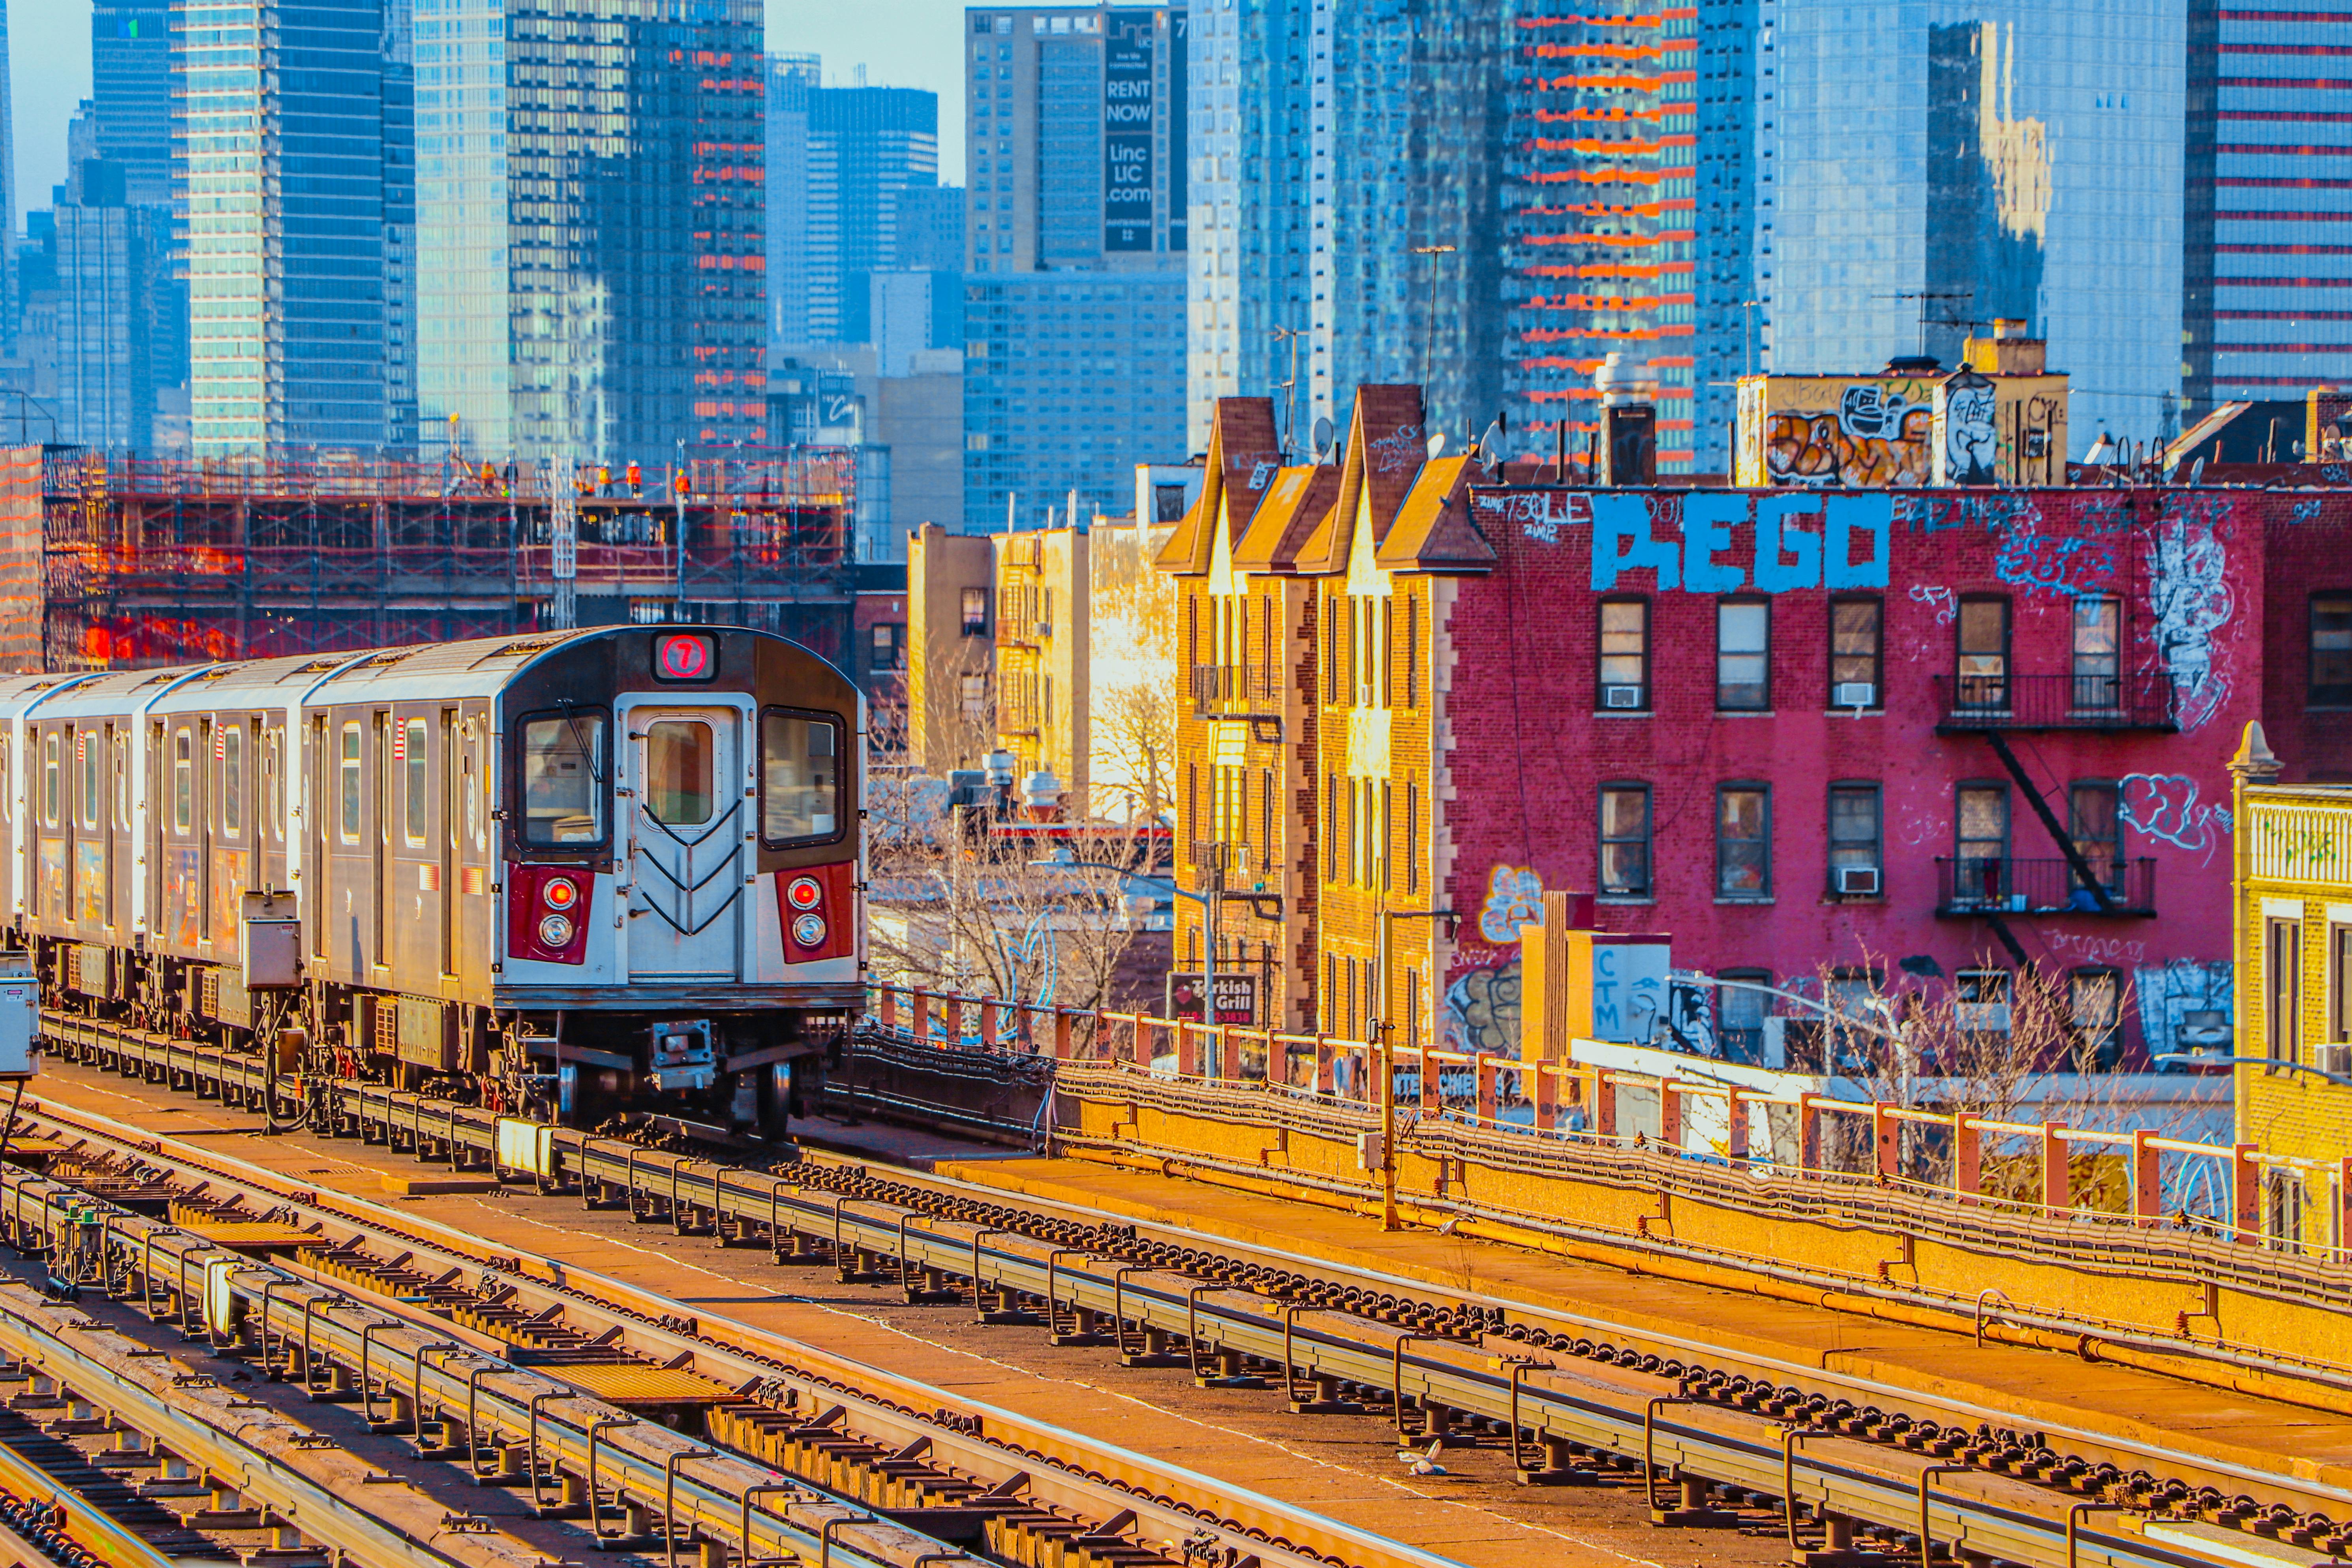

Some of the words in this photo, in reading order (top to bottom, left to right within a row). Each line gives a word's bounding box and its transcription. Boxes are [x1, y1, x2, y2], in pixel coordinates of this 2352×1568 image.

[1107, 80, 1151, 98] RENT
[1106, 104, 1151, 122] NOW
[1110, 143, 1147, 162] Linc
[1114, 164, 1143, 183] LIC
[1106, 187, 1151, 203] .com
[676, 643, 693, 669] 7
[1192, 979, 1252, 995] Trkish
[1216, 995, 1251, 1010] Grill
